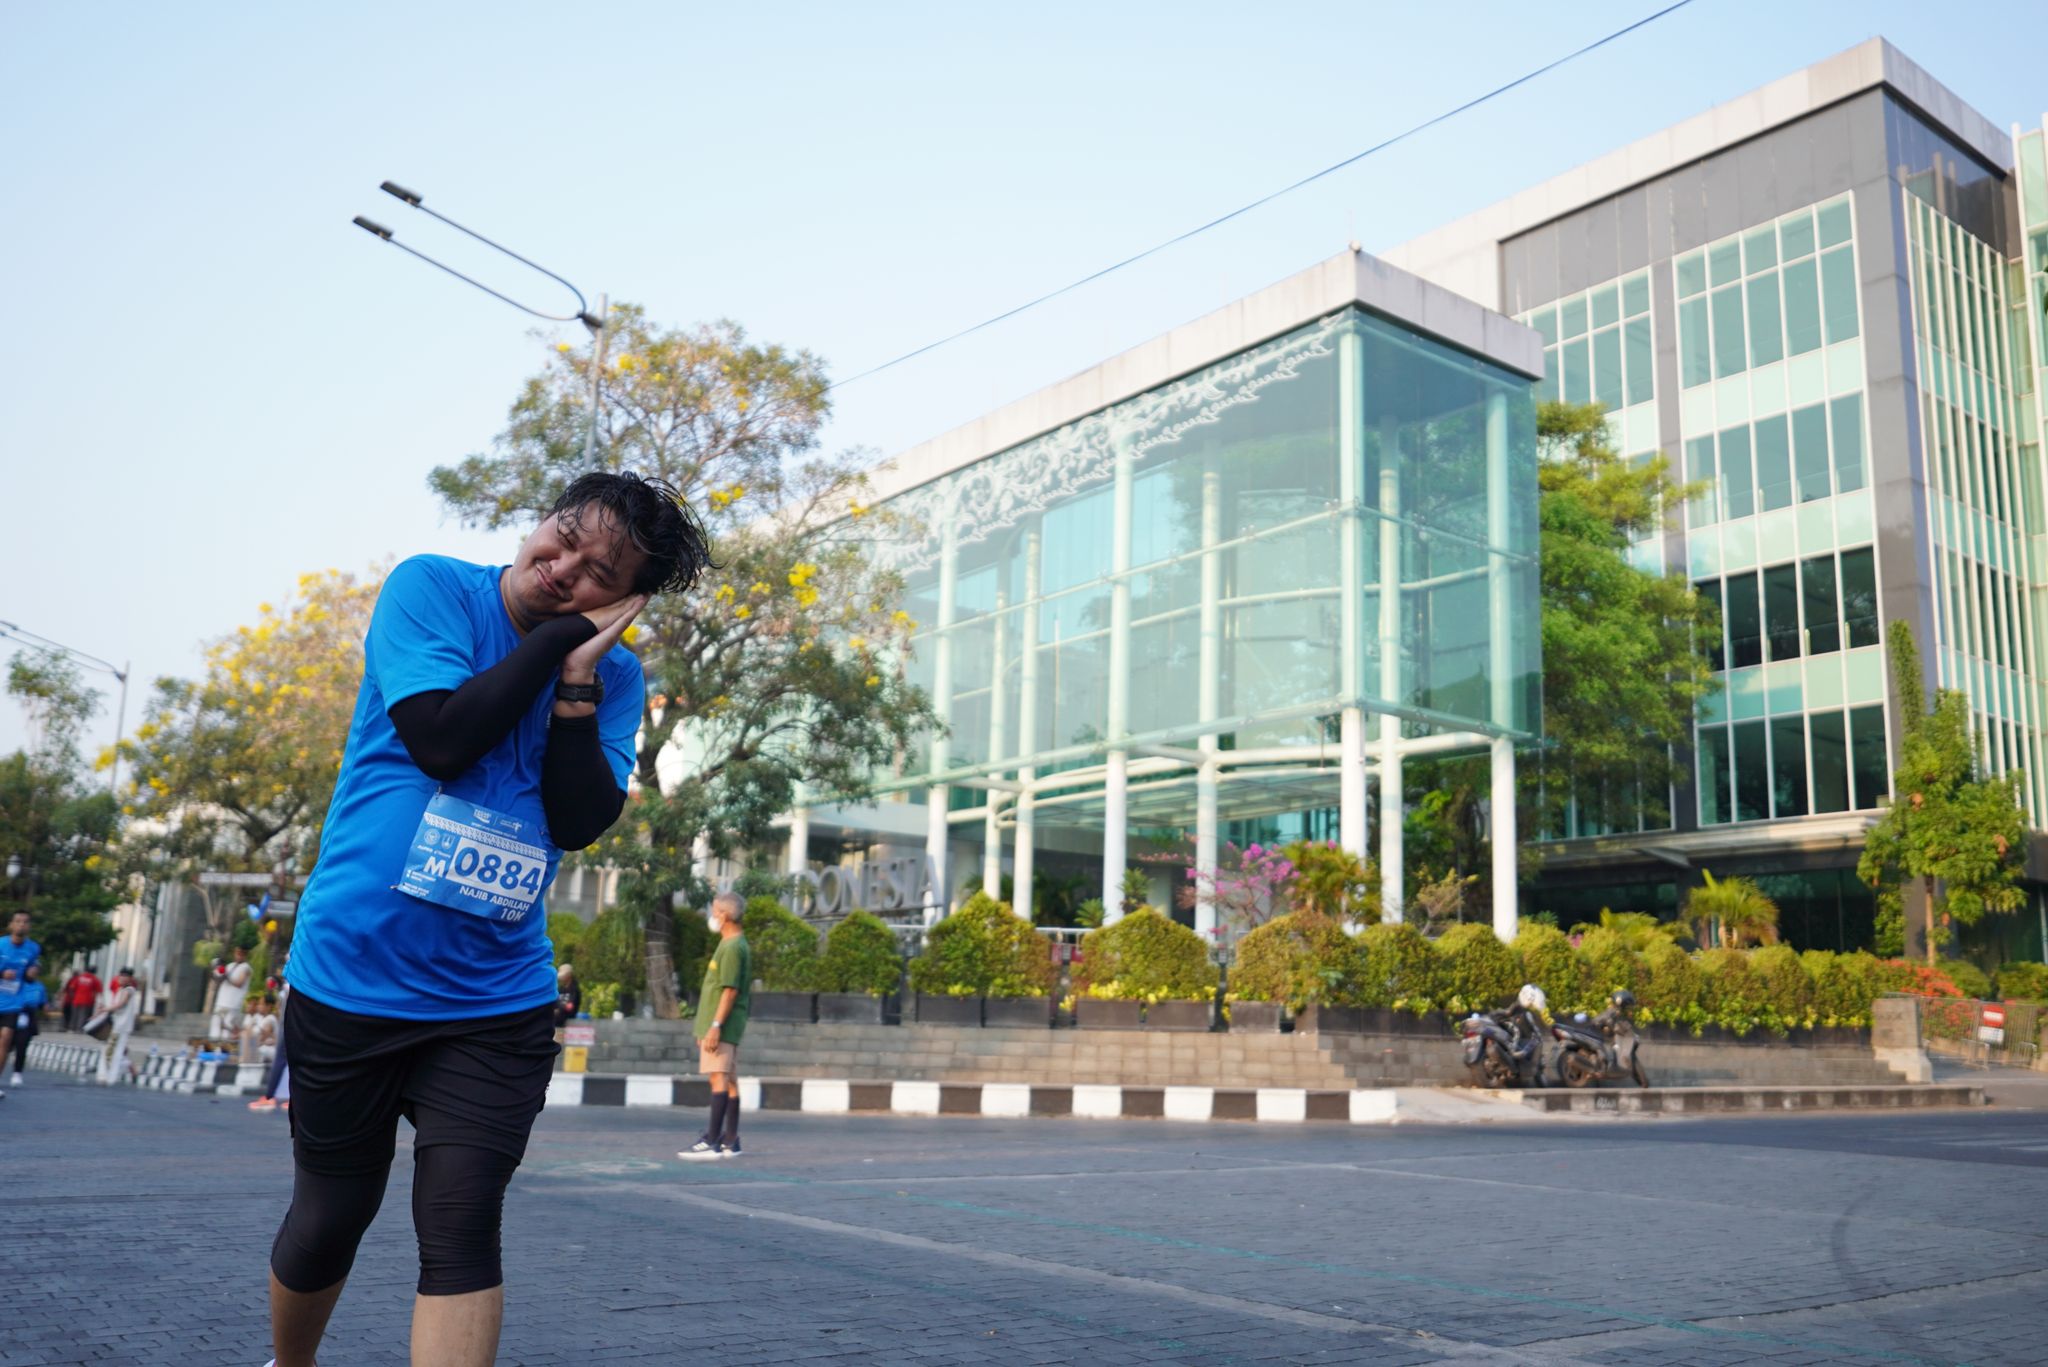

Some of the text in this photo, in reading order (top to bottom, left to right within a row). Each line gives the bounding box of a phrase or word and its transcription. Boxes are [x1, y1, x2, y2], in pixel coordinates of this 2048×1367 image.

[424, 856, 446, 878] M
[455, 847, 541, 895] 0884
[460, 886, 530, 911] NAJIB ABDILLAH
[501, 908, 525, 921] 10K
